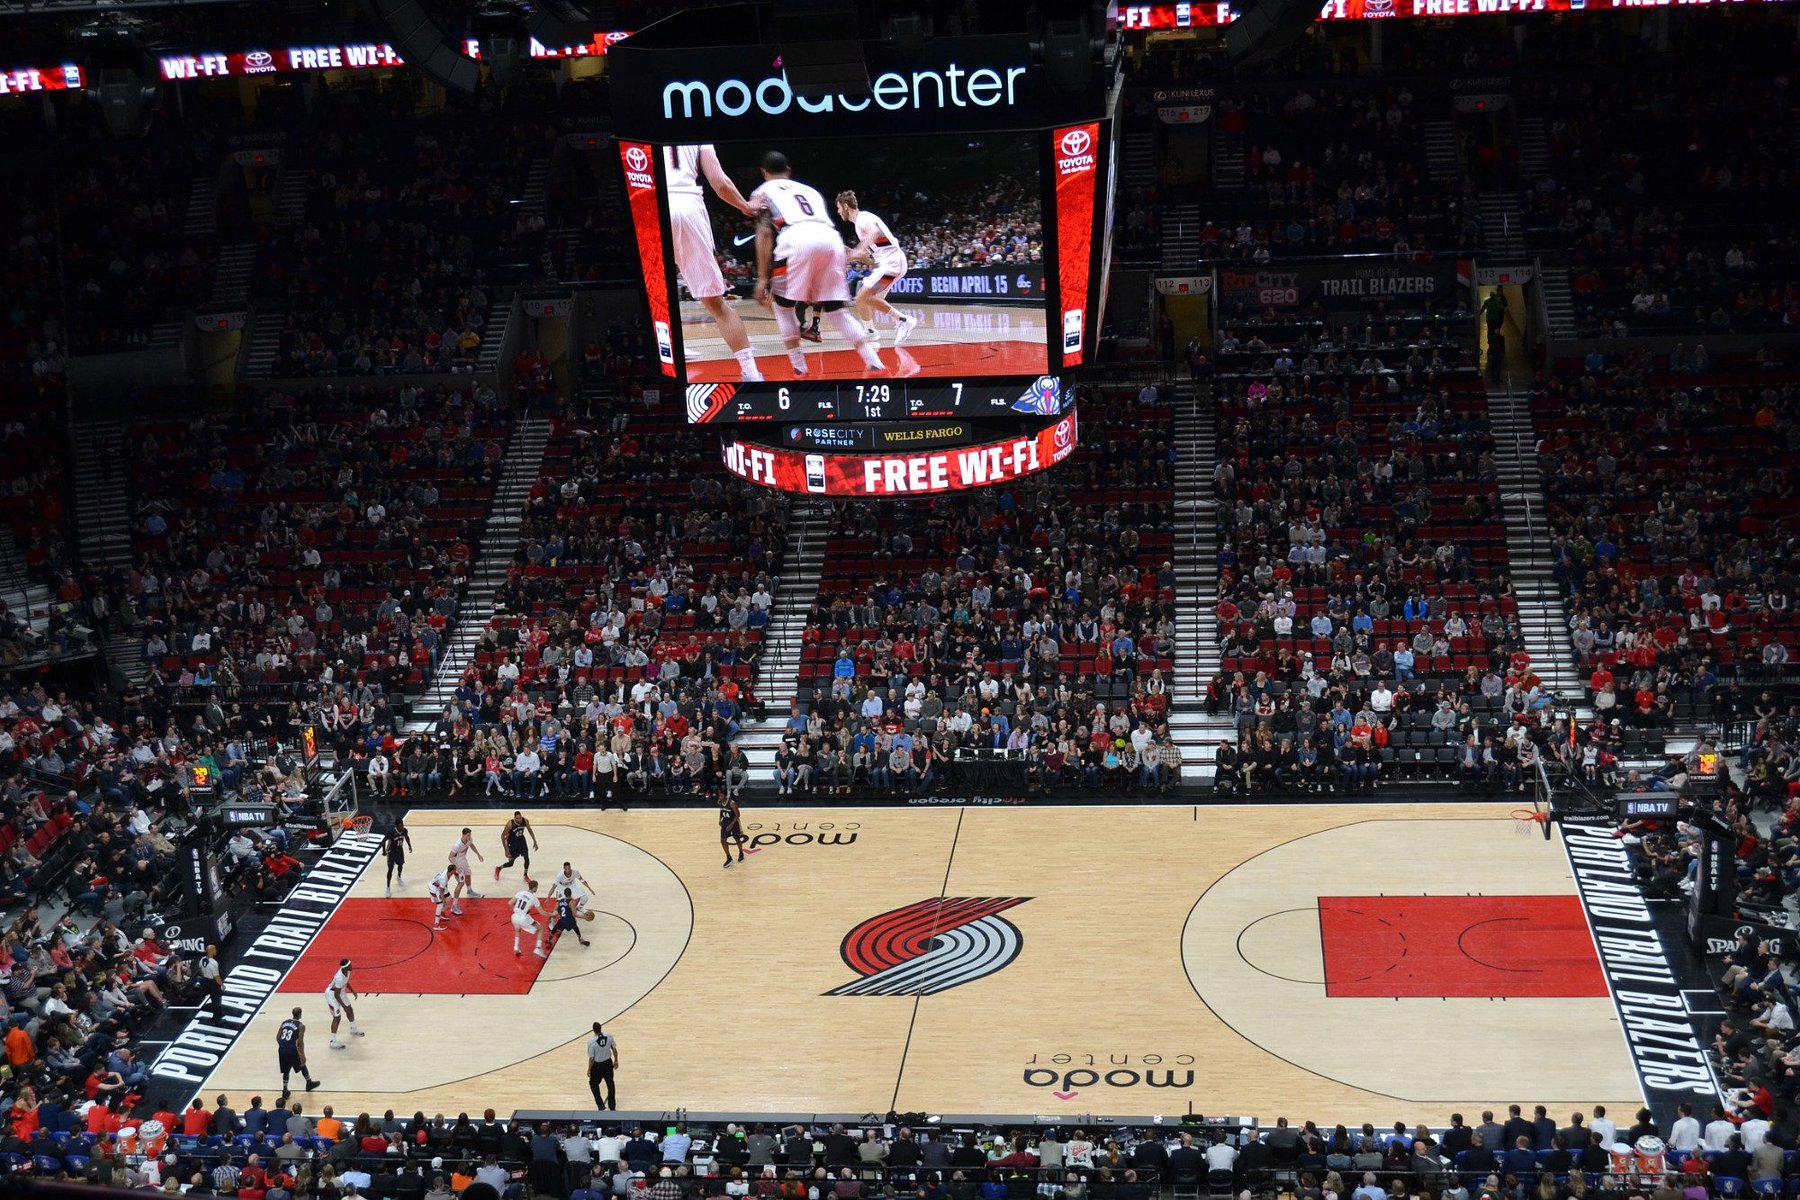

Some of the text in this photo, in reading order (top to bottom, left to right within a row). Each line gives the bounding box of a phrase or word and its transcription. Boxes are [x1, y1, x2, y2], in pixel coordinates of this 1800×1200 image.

[290, 48, 343, 69] FREE
[163, 56, 230, 79] WI-FI
[245, 66, 277, 74] TOYOTA
[1190, 88, 1214, 98] LEXUS
[1058, 155, 1093, 169] TOYOTA
[626, 171, 653, 183] TOYOTA
[931, 276, 960, 293] BEGIN
[961, 275, 993, 294] APRIL
[994, 275, 1008, 294] 15
[1017, 276, 1032, 288] abc
[1157, 280, 1175, 289] 112
[1193, 279, 1210, 287] 113
[1321, 276, 1435, 297] TRAIL BLAZERS
[1259, 289, 1297, 304] 620
[778, 387, 790, 410] 6
[855, 385, 890, 403] 7:29
[952, 383, 963, 405] 7
[818, 401, 833, 409] FLS.
[864, 405, 881, 418] 1st
[884, 426, 962, 441] WELLS FARGO
[815, 438, 854, 446] PARTNER
[1052, 445, 1073, 463] TOYOTA
[726, 441, 776, 485] WI-FI
[864, 436, 1040, 492] FREE WI-FI
[908, 796, 967, 805] oregon
[1637, 802, 1669, 813] NBA TV
[238, 812, 265, 821] NBA TV
[285, 822, 318, 830] @trailblazers
[746, 821, 861, 833] cente
[289, 830, 386, 904] BLAZERS
[1562, 823, 1650, 923] PORTLAND
[1710, 854, 1718, 891] NBA TV
[193, 861, 203, 894] NBA TV
[560, 906, 567, 917] 2
[243, 907, 329, 962] TRAIL
[1706, 937, 1780, 955] SPAG
[1595, 925, 1675, 985] TRAIL
[281, 1028, 293, 1041] 33
[1616, 989, 1715, 1096] BLAZERS
[1026, 1053, 1195, 1066] center
[1023, 1068, 1195, 1092] moda
